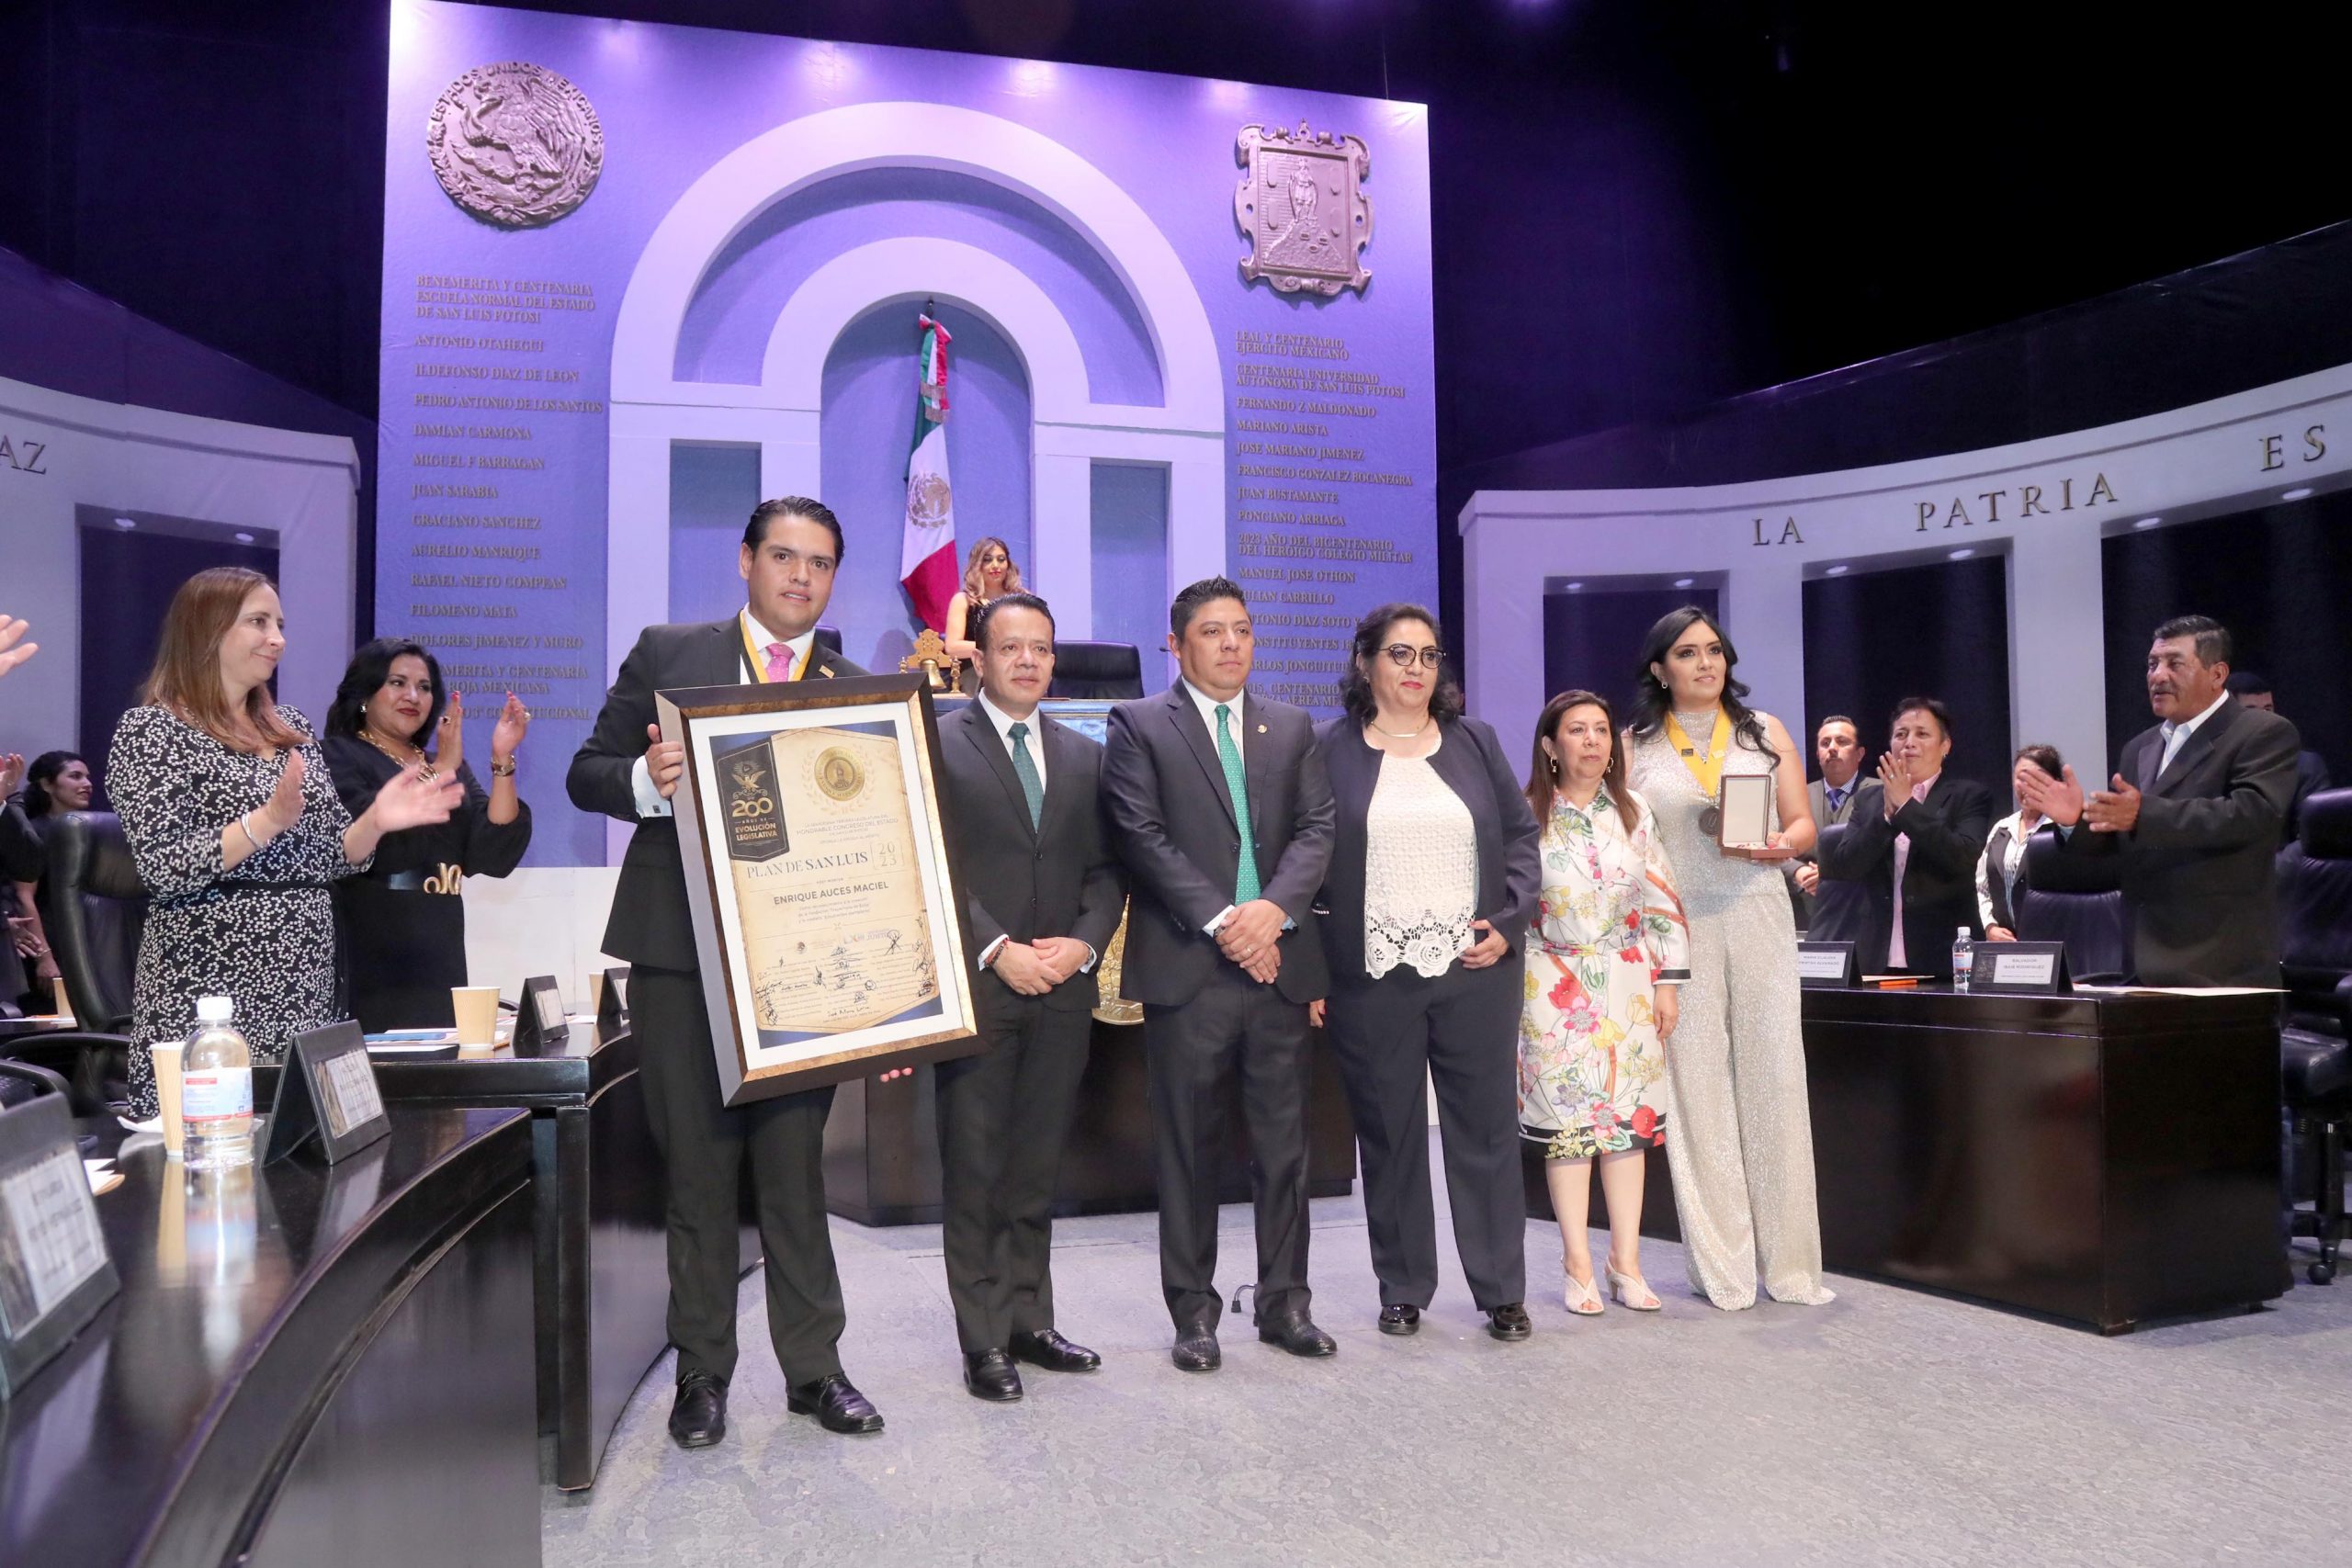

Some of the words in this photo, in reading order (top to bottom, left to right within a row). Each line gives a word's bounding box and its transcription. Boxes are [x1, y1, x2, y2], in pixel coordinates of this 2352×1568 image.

[430, 69, 482, 122] ESTADOS
[486, 62, 544, 77] UNIDOS
[546, 72, 604, 145] MEXICANOS
[416, 275, 500, 291] BENEMERITA
[503, 279, 509, 292] Y
[513, 280, 594, 297] CENTENARIA
[416, 291, 469, 305] ESCUELA
[470, 293, 522, 308] NORMAL
[524, 295, 546, 309] DEL
[549, 297, 595, 311] ESTADO
[416, 306, 434, 319] DE
[435, 307, 459, 320] SAN
[464, 308, 491, 321] LUIS
[494, 309, 540, 323] POTOSI
[414, 334, 475, 348] ANTONIO
[1236, 331, 1260, 343] LEAL
[1264, 332, 1272, 344] Y
[1275, 333, 1344, 349] CENTENARIO
[1236, 341, 1288, 355] EJERCITO
[1291, 345, 1349, 360] MEXICANO
[414, 364, 488, 379] ILDEFONSO
[491, 367, 520, 380] DIAZ
[523, 367, 541, 381] DE
[543, 368, 579, 383] LEON
[1236, 364, 1305, 379] CENTENARIA
[1307, 368, 1380, 384] UNIVERSIDAD
[1236, 376, 1298, 390] AUTONOMA
[1302, 379, 1316, 391] DE
[1318, 381, 1339, 393] SAN
[1340, 382, 1364, 395] LUIS
[1366, 385, 1406, 398] POTOSI
[414, 393, 457, 408] PEDRO
[458, 396, 513, 410] ANTONIO
[514, 397, 530, 411] DE
[532, 398, 557, 412] LOS
[558, 400, 604, 413] SANTOS
[1237, 397, 1296, 412] FERNANDO
[1308, 402, 1376, 418] MALDONADO
[413, 423, 465, 437] DAMIAN
[468, 426, 532, 440] CARMONA
[1237, 421, 1288, 434] MARIANO
[1291, 423, 1329, 436] ARISTA
[1236, 442, 1262, 457] JOSE
[1265, 444, 1316, 457] MARIANO
[1318, 446, 1365, 461] JIMENEZ
[413, 454, 465, 468] MIGUEL
[478, 456, 545, 470] BARRAGAN
[1238, 464, 1295, 479] FRANCISCO
[1296, 467, 1351, 481] GONZALEZ
[1352, 470, 1412, 486] BOCANEGRA
[412, 484, 444, 501] JUAN
[447, 484, 499, 499] SARABIA
[1753, 515, 1804, 547] LA
[1914, 472, 2120, 532] PATRIA
[2258, 424, 2326, 472] ES
[1236, 487, 1264, 501] JUAN
[1267, 489, 1339, 503] BUSTAMANTE
[412, 513, 479, 527] GRACIANO
[481, 515, 542, 530] SANCHEZ
[1238, 511, 1296, 524] PONCIANO
[1298, 513, 1346, 526] ARRIAGA
[1239, 533, 1261, 546] 2023
[1264, 533, 1286, 546] AÑO
[1289, 536, 1311, 547] DEL
[1313, 536, 1394, 551] BICENTENARIO
[412, 544, 469, 558] AURELIO
[470, 545, 541, 563] MANRIQUE
[1238, 544, 1260, 557] DEL
[1263, 545, 1315, 558] HEROICO
[1317, 548, 1365, 561] COLEGIO
[1369, 551, 1413, 564] MILITAR
[411, 573, 458, 587] RAFAEL
[459, 574, 501, 588] NIETO
[503, 575, 568, 589] COMPEAN
[1239, 567, 1286, 581] MANUEL
[1286, 569, 1313, 583] JOSE
[1316, 570, 1356, 583] OTHON
[1243, 590, 1277, 603] ULIAN
[1279, 592, 1335, 604] CARRILLO
[411, 604, 480, 617] FILOMENO
[482, 604, 518, 618] MATA
[1251, 613, 1291, 626] TONIO
[1294, 615, 1319, 626] DIAZ
[1321, 616, 1351, 628] SOTO
[412, 634, 471, 648] DOLORES
[473, 635, 530, 650] JIMENEZ
[531, 636, 541, 648] Y
[543, 636, 583, 649] MURO
[496, 665, 504, 678] Y
[507, 665, 588, 679] CENTENARIA
[447, 681, 478, 697] ROJA
[481, 682, 550, 695] MEXICANA
[1271, 682, 1340, 695] CENTENARIO
[731, 797, 773, 818] 200
[735, 822, 776, 833] EVOLUCIÓN
[796, 826, 831, 835] HONORABLE
[832, 822, 864, 831] CONGRESO
[876, 818, 899, 826] ESTADO
[736, 830, 778, 841] LEGISLATIVA
[877, 841, 895, 854] 20
[747, 863, 783, 879] PLAN
[786, 860, 803, 874] DE
[805, 856, 834, 871] SAN
[836, 852, 868, 866] LUIS
[879, 854, 897, 866] 23
[774, 891, 818, 906] ENRIQUE
[820, 886, 852, 899] AUCES
[854, 881, 889, 895] MACIEL
